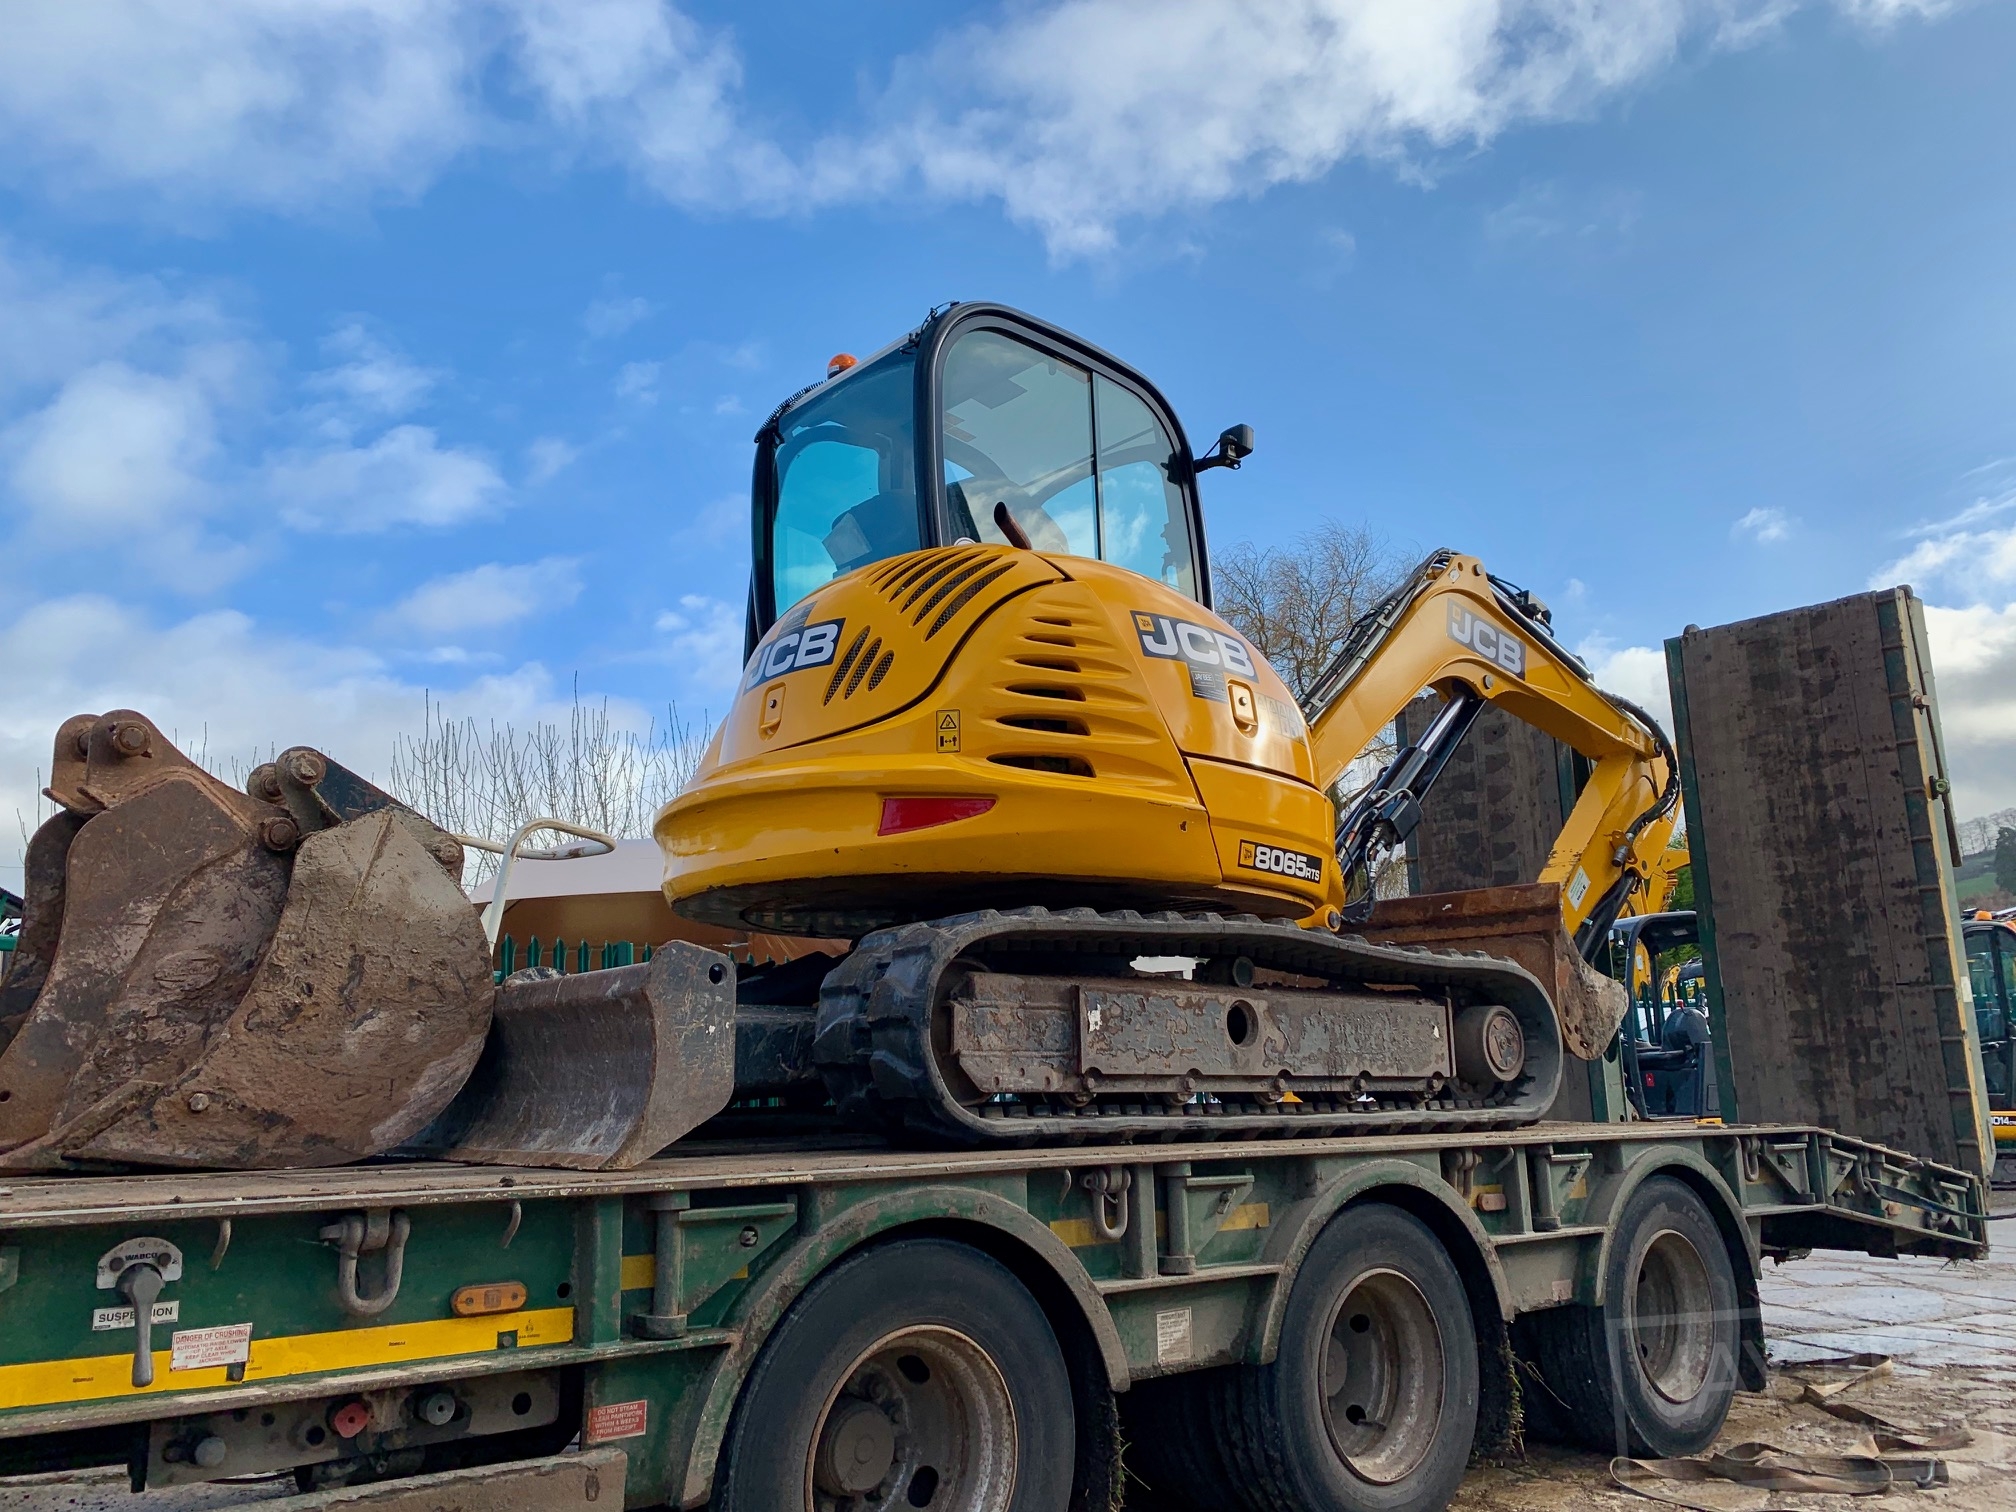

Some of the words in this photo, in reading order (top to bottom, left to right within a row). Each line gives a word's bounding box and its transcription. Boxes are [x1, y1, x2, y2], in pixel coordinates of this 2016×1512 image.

[1142, 618, 1255, 677] JCB
[1452, 612, 1521, 674] JCB
[745, 623, 839, 690] JCB
[125, 1253, 158, 1261] WABCO
[99, 1307, 173, 1323] SUSPEION
[175, 1333, 203, 1344] DANGER
[204, 1332, 213, 1340] OF
[214, 1328, 248, 1339] CRUSHING
[176, 1343, 209, 1351] AUTOMATIC
[595, 1420, 615, 1429] WITHIN
[621, 1417, 640, 1425] WEEKS
[614, 1424, 637, 1432] RECEIPT
